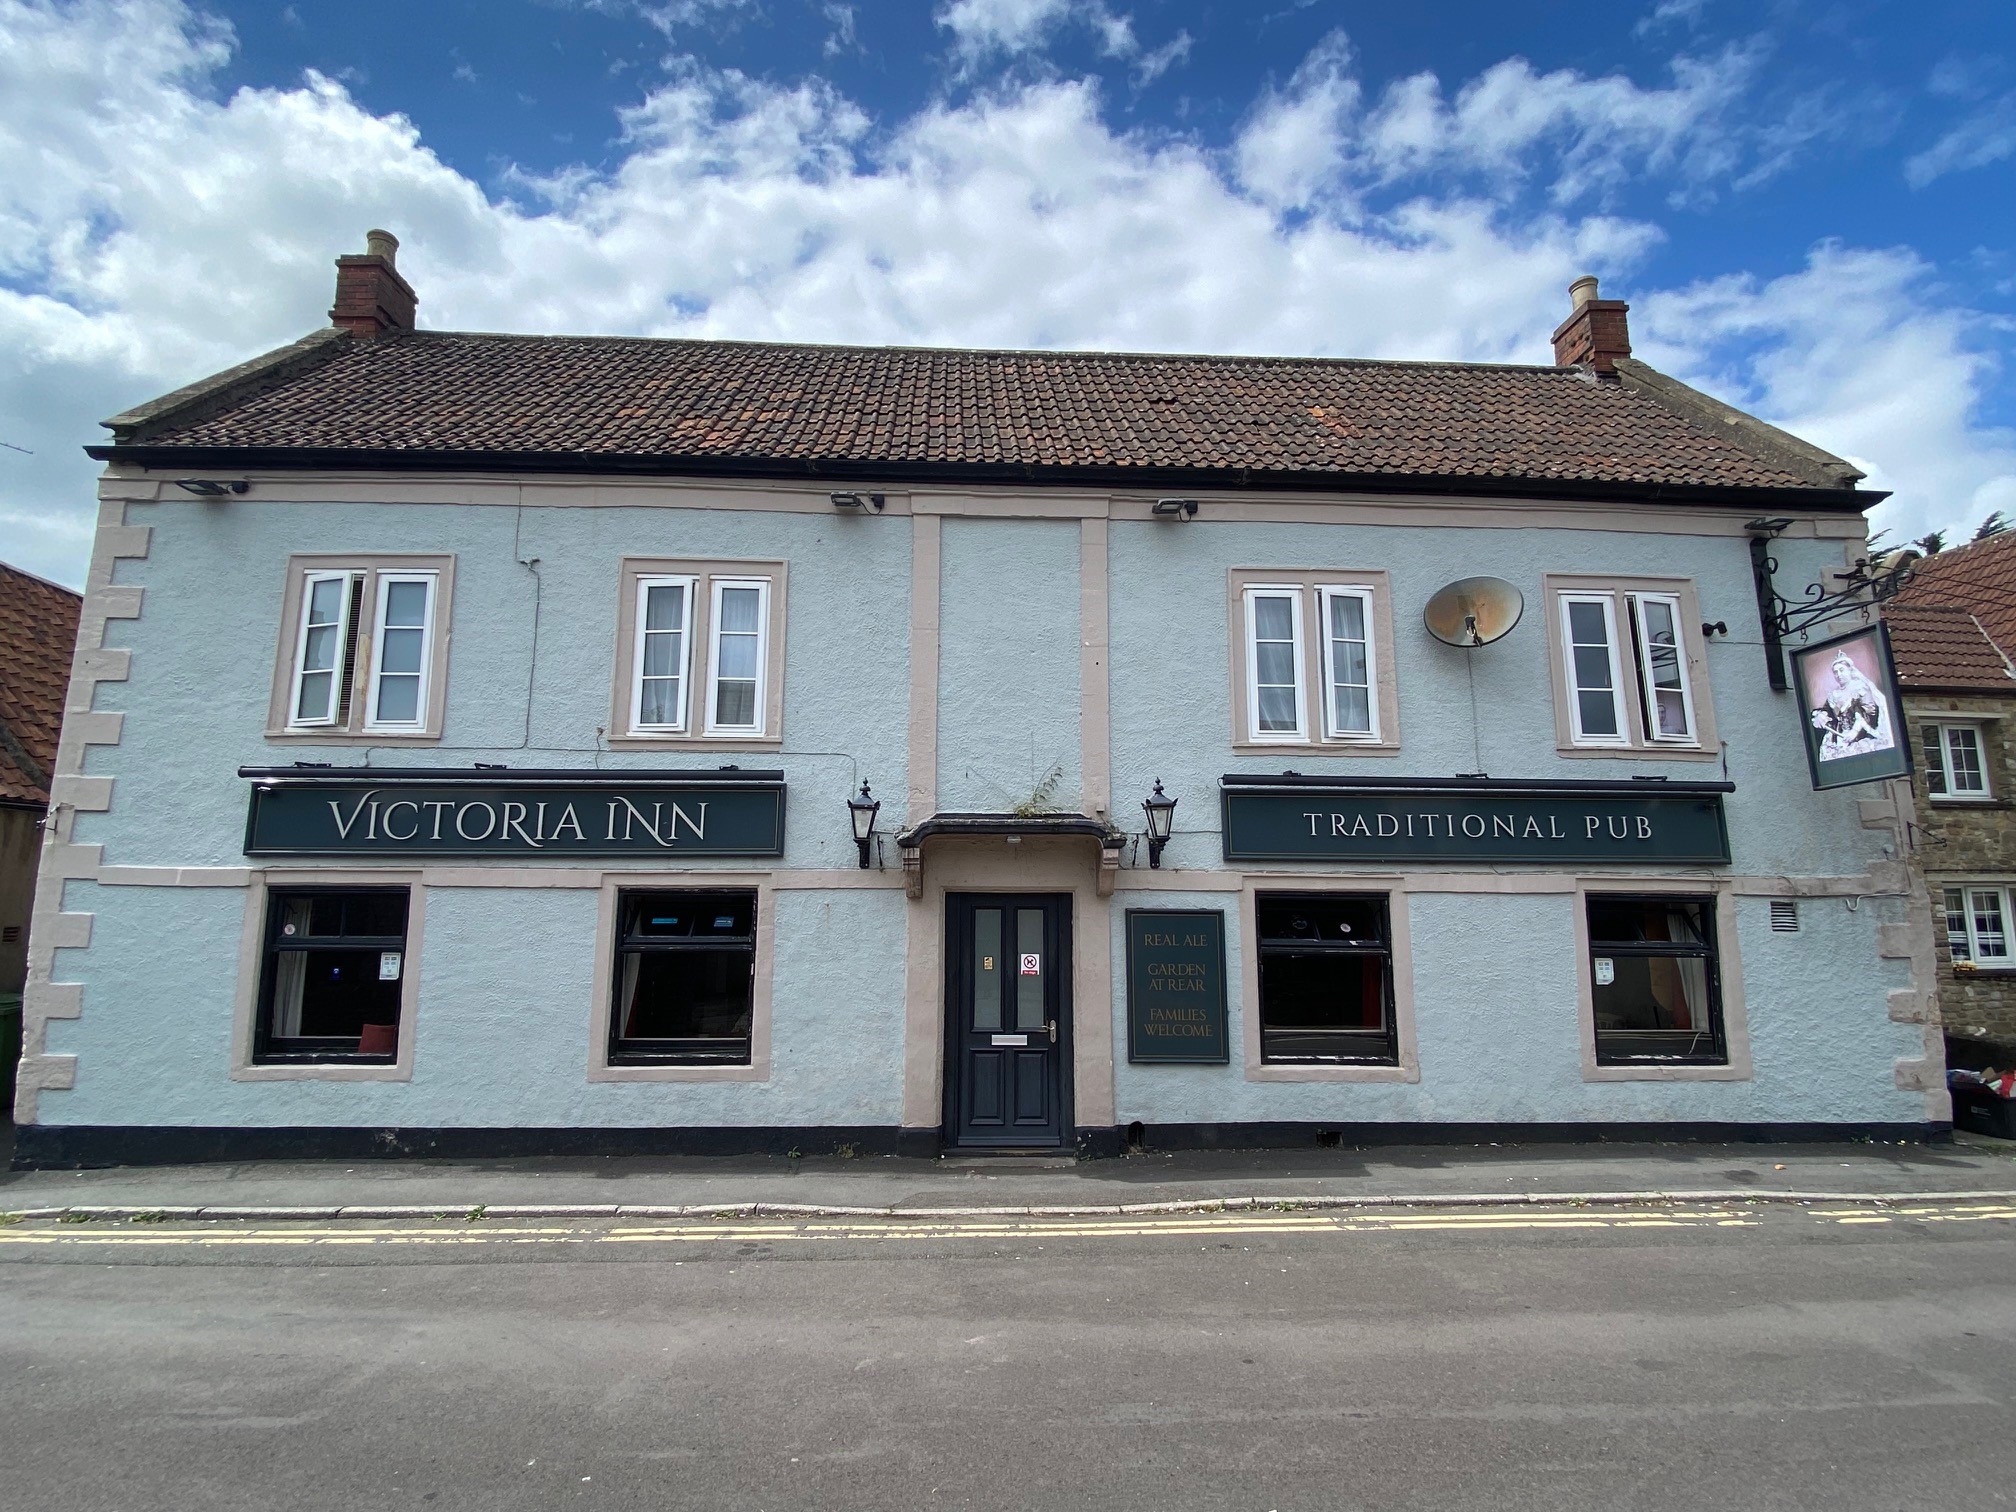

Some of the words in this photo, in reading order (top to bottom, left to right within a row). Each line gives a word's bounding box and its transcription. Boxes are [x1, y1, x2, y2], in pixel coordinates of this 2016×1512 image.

[326, 789, 588, 848] VICTORIA
[604, 796, 710, 847] INN
[1302, 812, 1566, 839] TRADITIONAL
[1584, 815, 1653, 840] PUB
[1144, 934, 1179, 946] REAL
[1183, 934, 1208, 947] ALE
[1147, 963, 1206, 976] GARDEN
[1148, 978, 1165, 991] AT
[1168, 978, 1206, 992] REAR
[1150, 1008, 1207, 1021] FAMILIES
[1144, 1023, 1214, 1037] WELCOME
